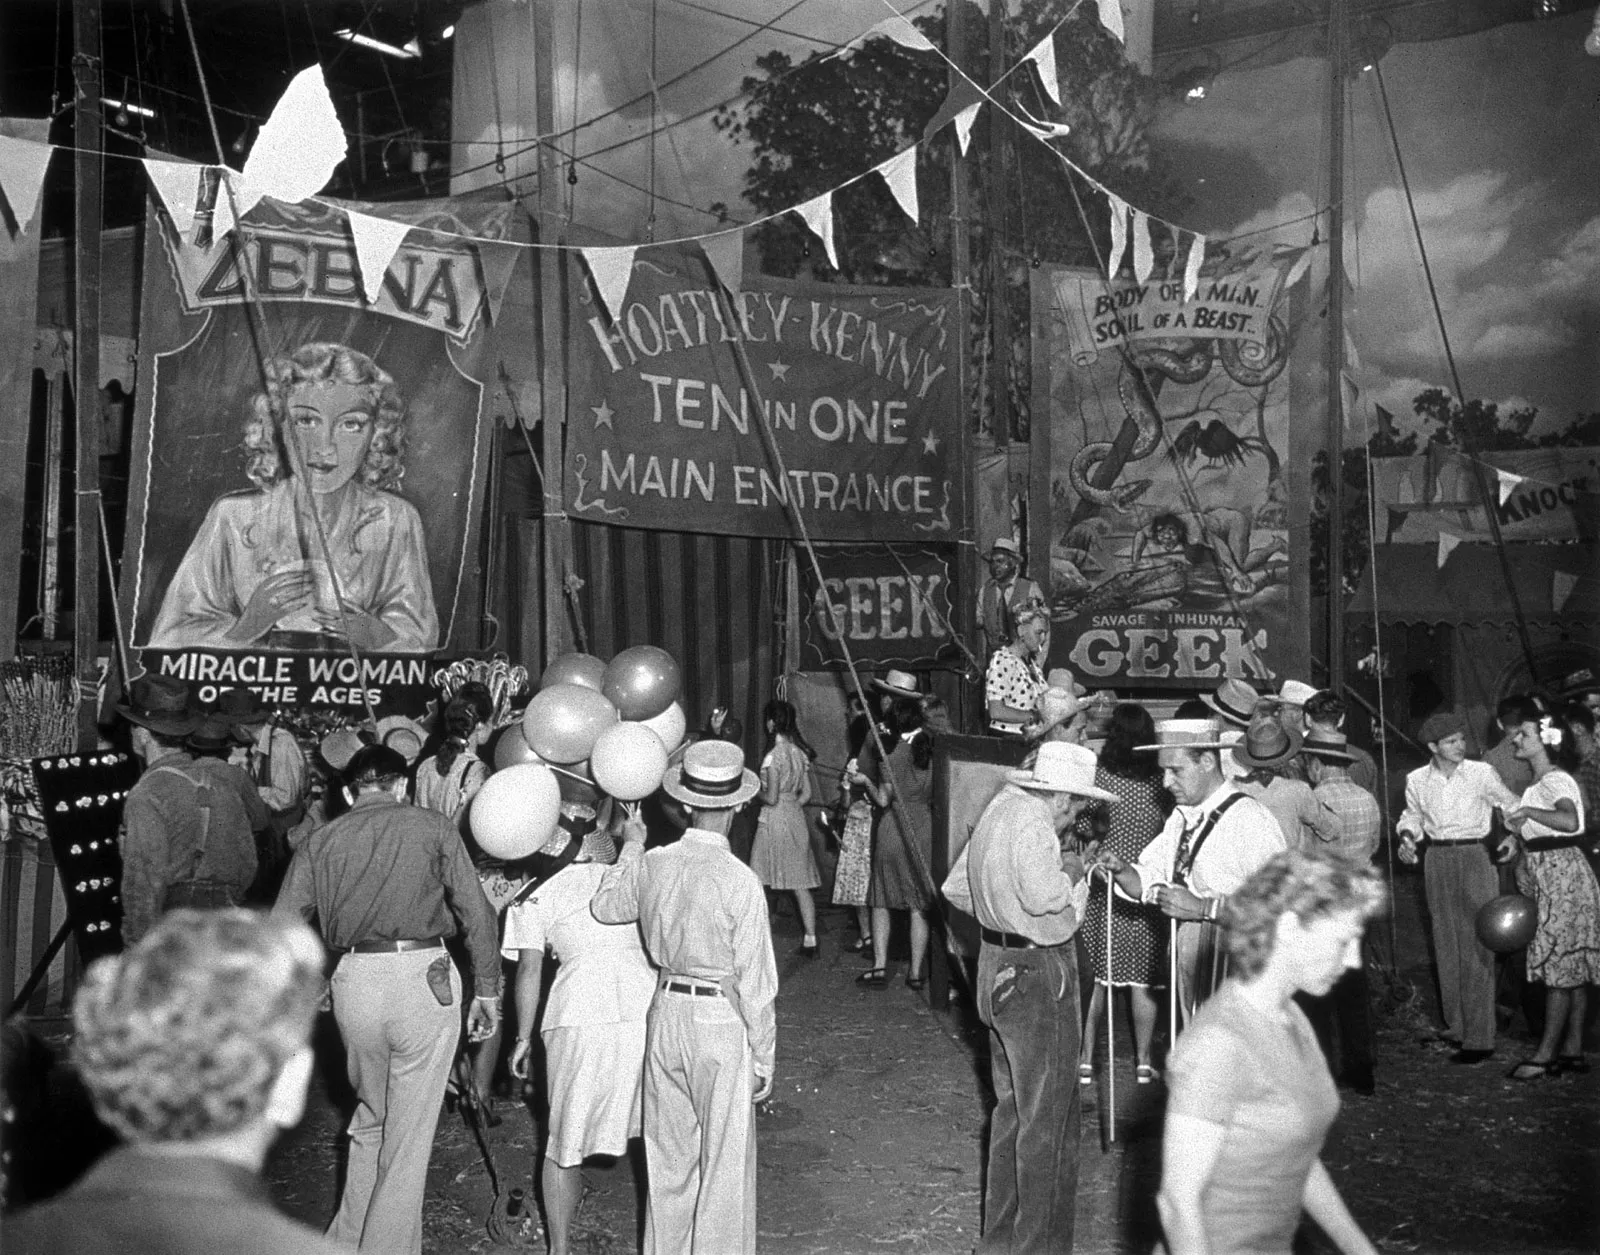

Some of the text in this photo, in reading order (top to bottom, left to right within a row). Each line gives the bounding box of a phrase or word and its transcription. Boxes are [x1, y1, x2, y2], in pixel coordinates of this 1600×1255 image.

[1094, 286, 1149, 317] BODY
[1154, 313, 1171, 329] OF
[1174, 312, 1187, 328] A
[640, 372, 908, 445] TEN IN ONE
[601, 449, 934, 513] MAIN ENTRANCE
[814, 574, 946, 640] GEEK
[1092, 613, 1248, 629] SAVAGE INHUMAN
[160, 653, 427, 686] MIRACLE WOMAN
[1069, 628, 1276, 680] GEEK
[311, 686, 382, 706] AGES
